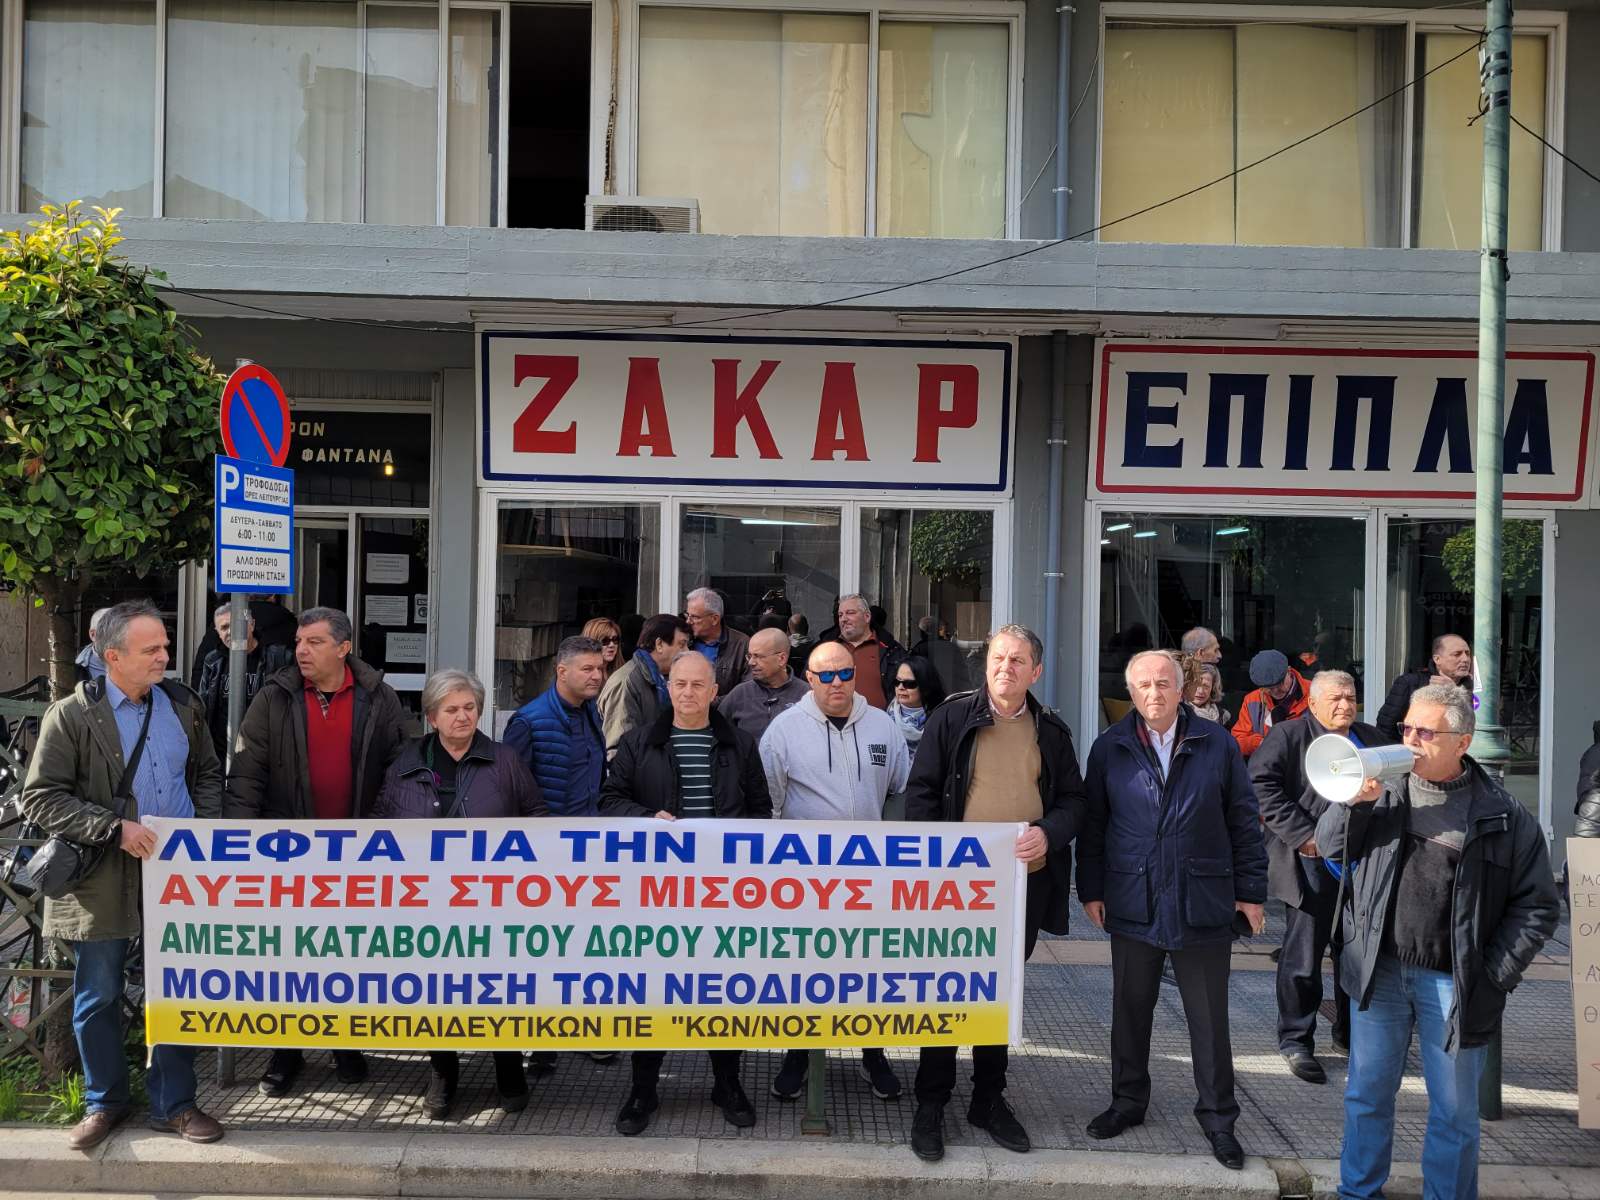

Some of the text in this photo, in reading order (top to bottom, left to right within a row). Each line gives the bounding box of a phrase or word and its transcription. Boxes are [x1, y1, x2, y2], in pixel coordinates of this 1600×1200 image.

[513, 354, 979, 463] ΖΑΚΑΡ
[1121, 371, 1555, 475] ΕΠΙΠΛΑ
[302, 448, 394, 464] ΦΑΝΤΑΝΑ
[221, 463, 240, 504] P
[245, 476, 289, 493] ΤΡΟΦΟΔΟΣΙΑ
[227, 569, 286, 581] ΠΡΟΣΩΡΙΝΗ ΣΤΑΣΗ
[235, 555, 278, 568] ΑΛΛΟ ΩΡΑΡΙΟ
[158, 829, 991, 868] ΛΕΦΤΑ ΓΙΑ ΤΗΝ ΠΑΙΔΕΙΑ
[158, 873, 997, 911] ΑΥΞΗΣΕΙΣ ΣΤΟΥΣ ΜΙΣΘΟΥΣ ΜΑΣ
[160, 921, 997, 959] ΑΜΕΣΗ ΚΑΤΑΒΟΛΗ ΤΟΥ ΔΩΡΟΥ ΧΡΙΣΤΟΥΓΕΝΝΩΝ
[162, 967, 998, 1005] ΜΟΝΙΜΟΠΟΙΗΣΗ ΤΩΝ ΝΕΟΔΙΟΡΙΣΤΩΝ
[179, 1010, 340, 1037] ΣΥΛΛΟΓΟΣ
[349, 1015, 601, 1038] ΕΚΠΑΙΔΕΥΤΙΚΩΝ
[613, 1015, 653, 1038] ΠΕ
[671, 1014, 821, 1038] "ΚΩΝ/ΝΟΣ
